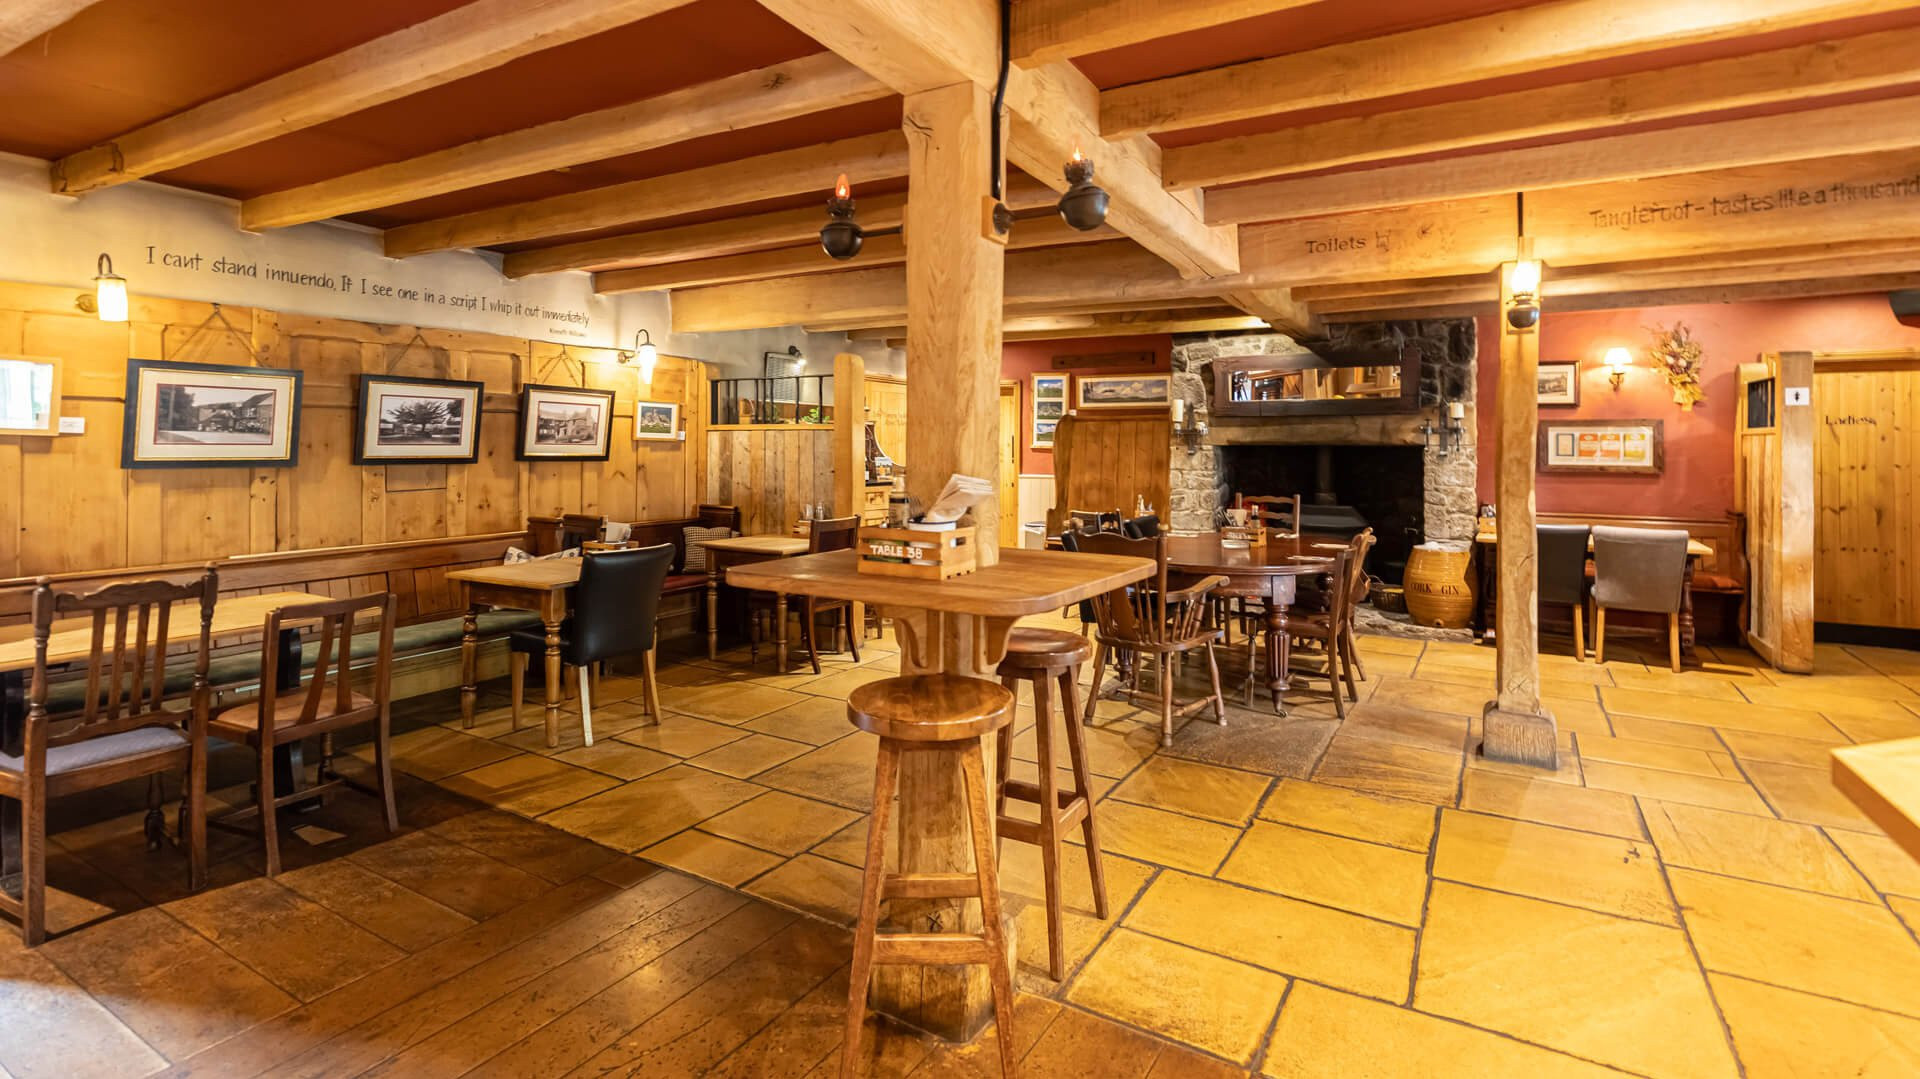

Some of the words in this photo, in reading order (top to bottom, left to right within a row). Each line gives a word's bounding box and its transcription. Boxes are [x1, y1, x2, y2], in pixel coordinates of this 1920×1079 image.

[1711, 194, 1774, 216] tastes
[1778, 187, 1810, 206] like
[1814, 189, 1826, 204] a
[1305, 236, 1367, 254] Toilets
[146, 246, 156, 265] I
[211, 257, 257, 279] stand
[360, 278, 367, 294] I
[372, 284, 393, 297] see
[398, 288, 418, 301] one
[424, 288, 434, 303] in
[438, 294, 445, 304] a
[450, 294, 477, 311] script
[481, 297, 486, 311] I
[490, 300, 512, 316] whip
[515, 303, 522, 315] it
[525, 306, 540, 318] out
[869, 545, 902, 558] TABLE
[905, 546, 923, 560] 38
[1441, 584, 1460, 595] GIN
